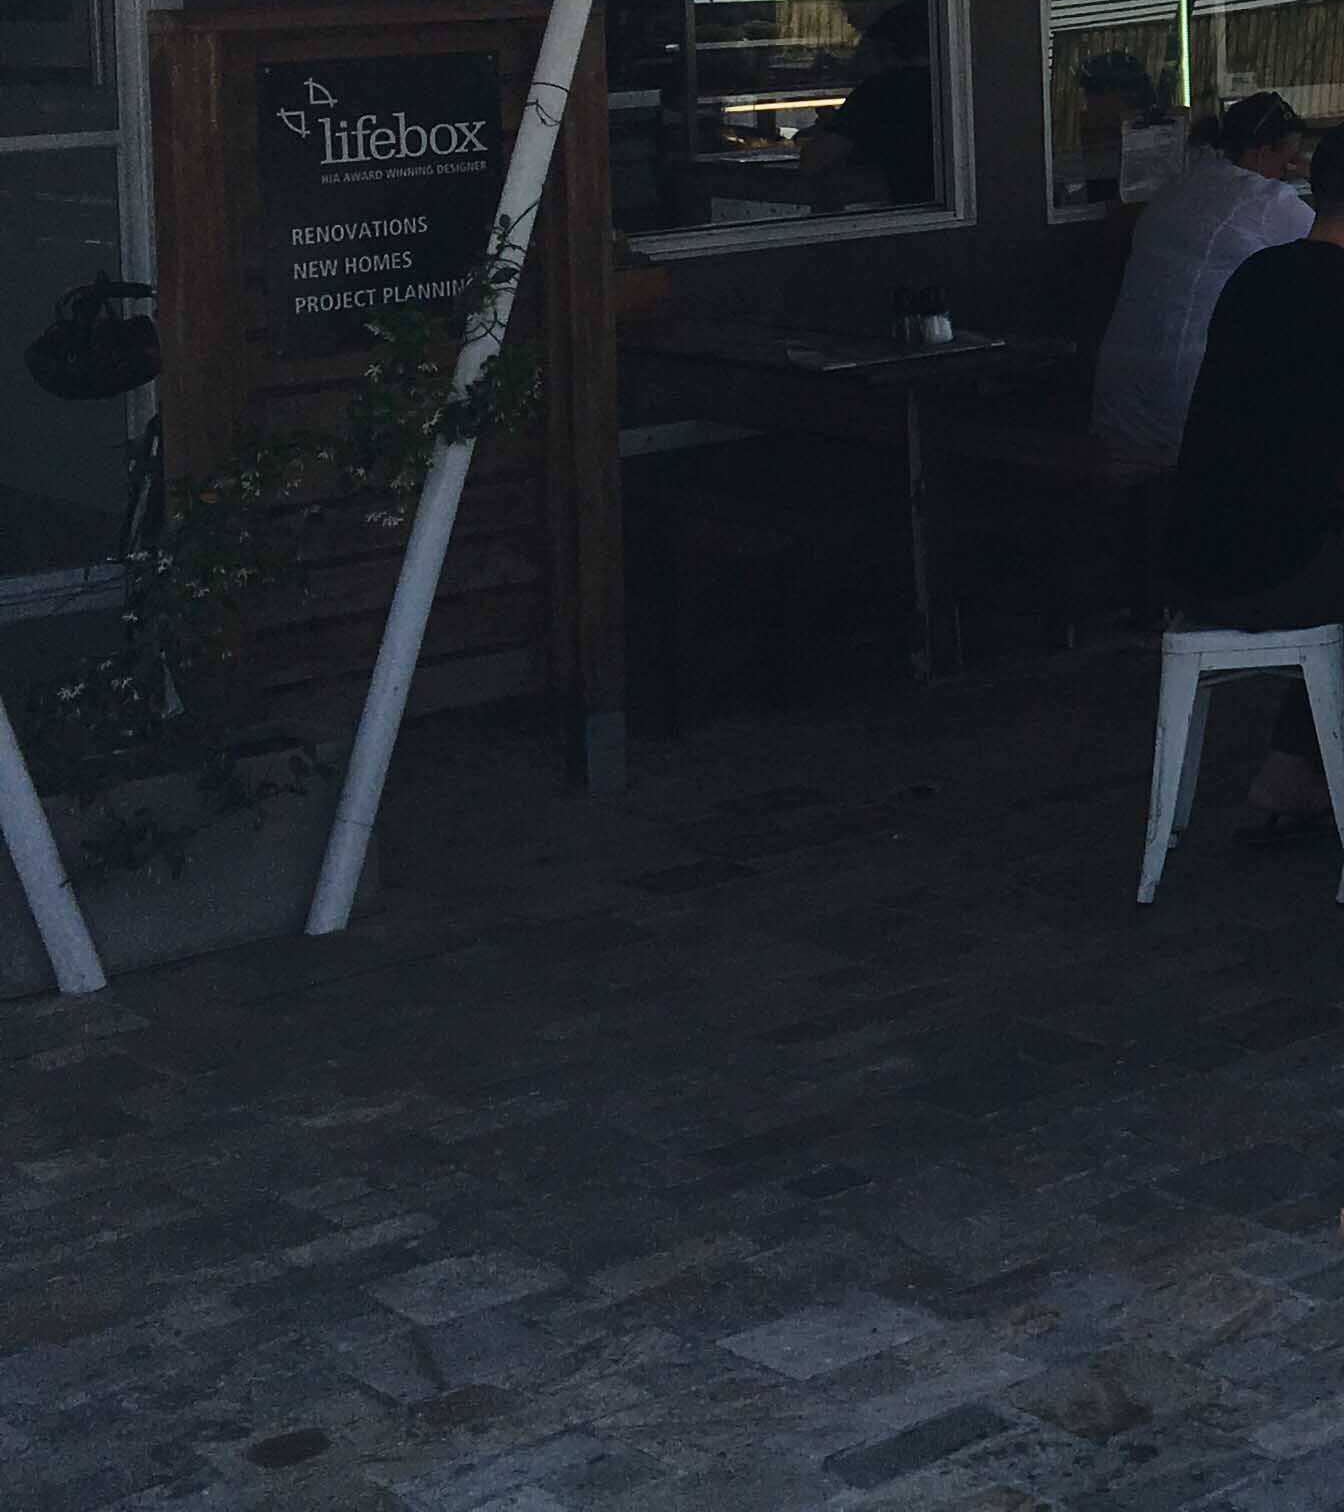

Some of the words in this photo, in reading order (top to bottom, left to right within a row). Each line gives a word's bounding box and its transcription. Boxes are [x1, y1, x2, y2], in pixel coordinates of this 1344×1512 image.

[317, 111, 489, 165] lifebox
[342, 169, 383, 183] AWARD
[385, 165, 434, 178] WINNING
[436, 160, 487, 175] DESIGNER
[291, 216, 429, 246] RENOVATIONS
[293, 260, 338, 280] NEW
[344, 251, 413, 275] HOMES
[295, 289, 377, 314] PROJECT
[383, 274, 474, 304] PLANNIN
